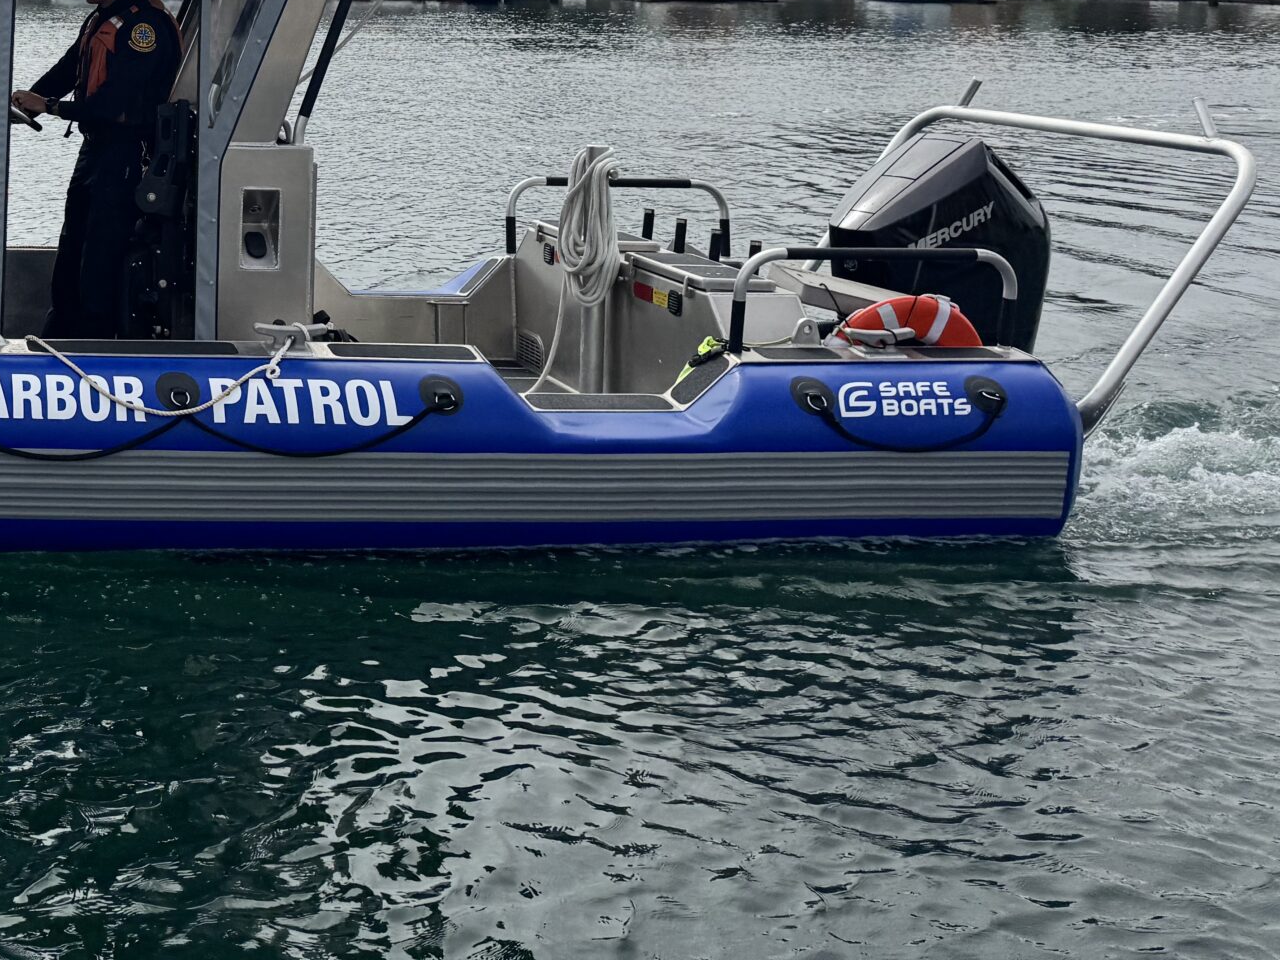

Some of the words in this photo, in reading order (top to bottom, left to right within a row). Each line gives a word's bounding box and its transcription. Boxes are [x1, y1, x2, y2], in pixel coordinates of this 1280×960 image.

[878, 381, 951, 397] SAFE
[208, 378, 414, 427] PATROL
[881, 398, 972, 416] BOATS
